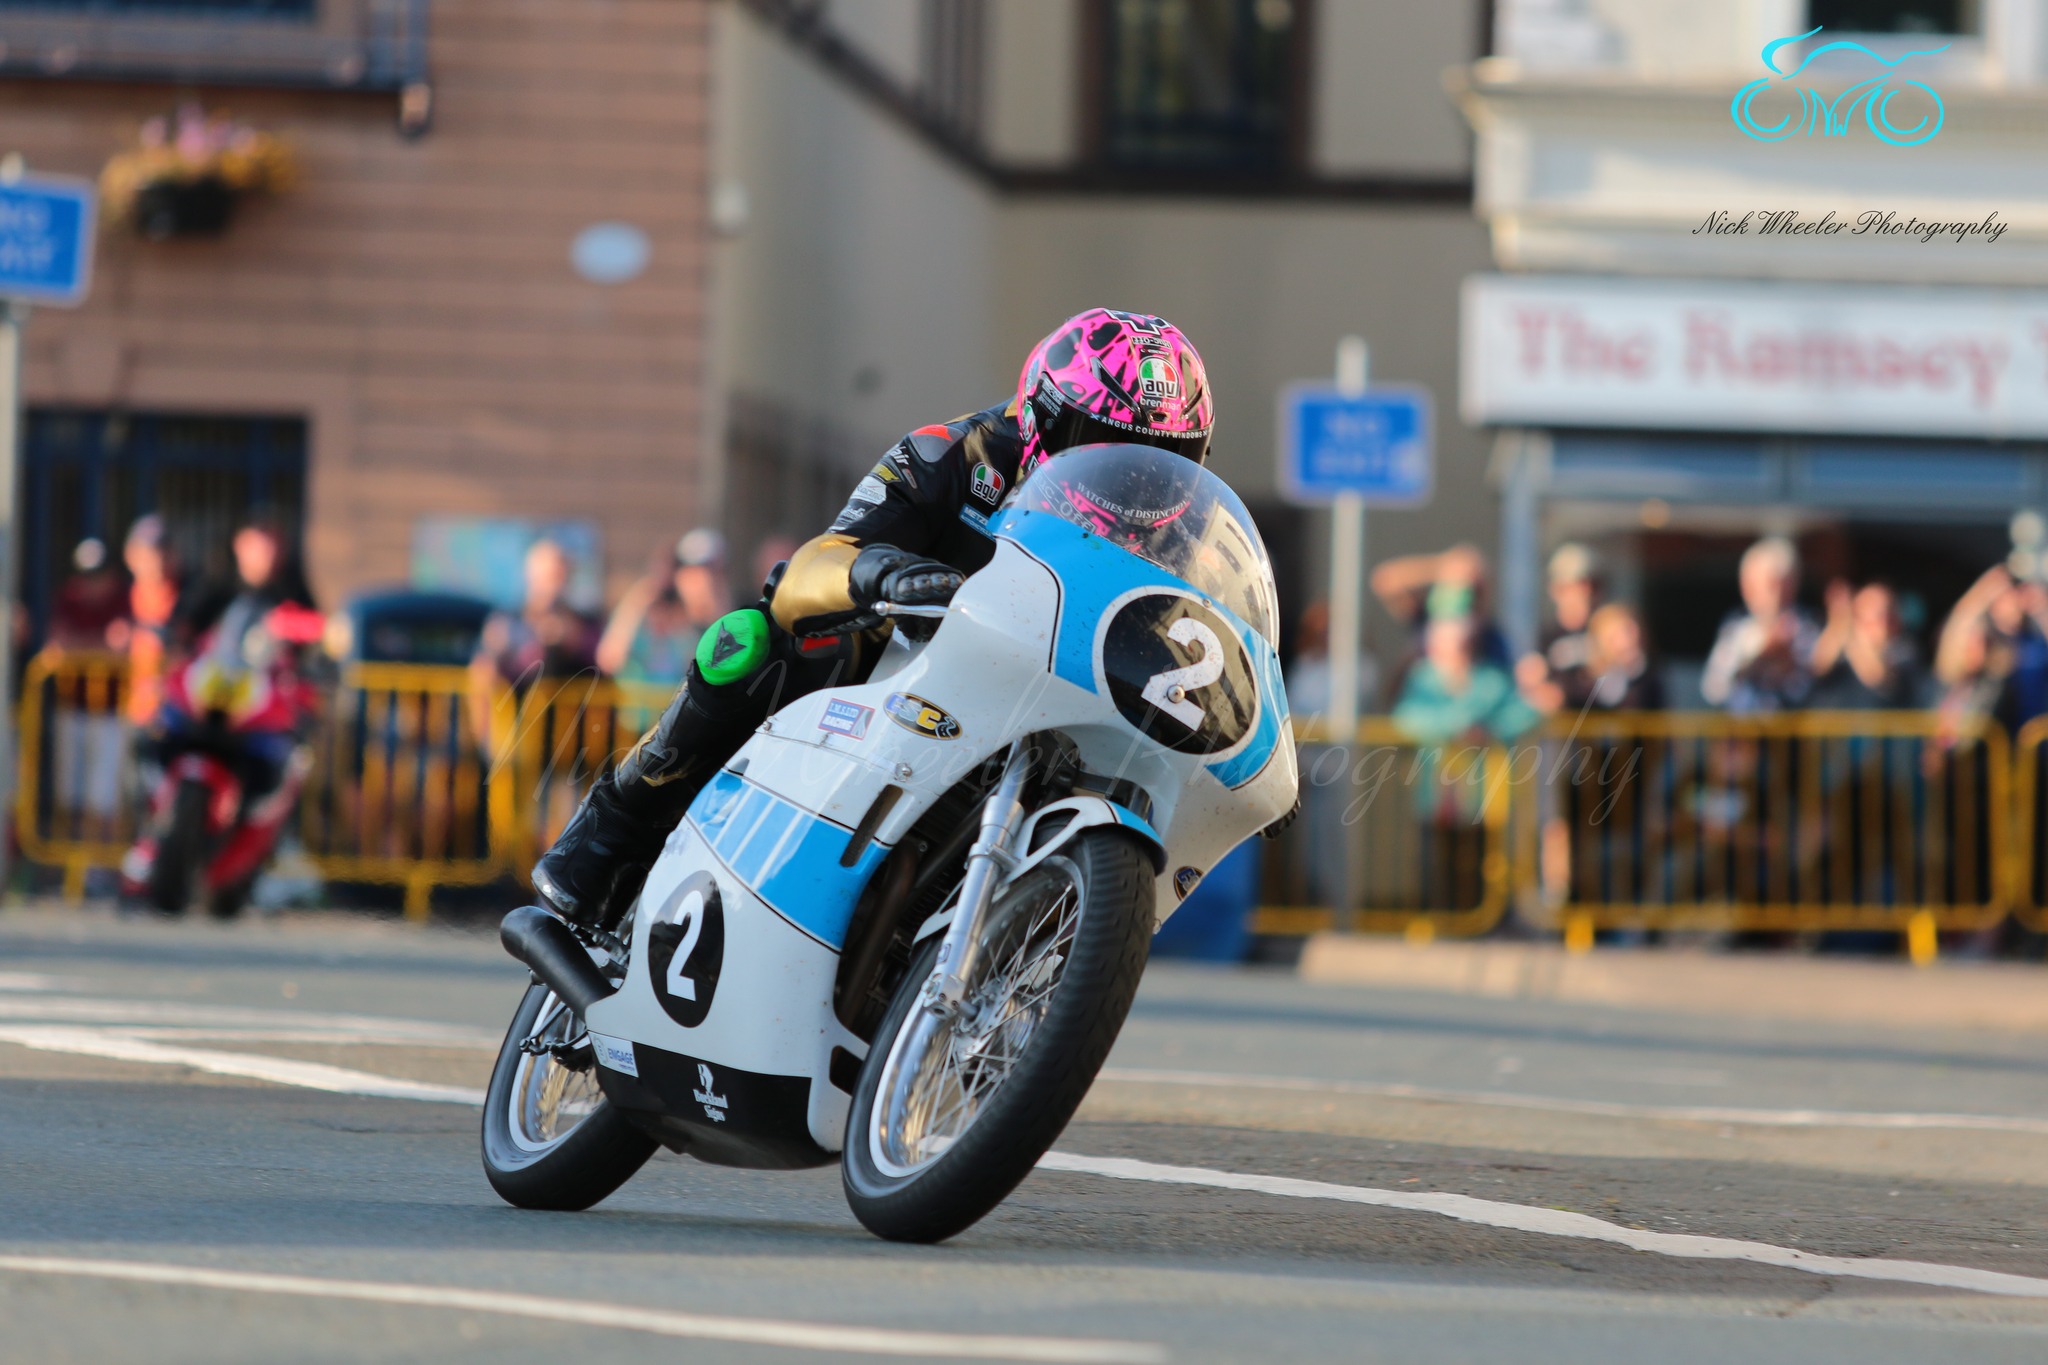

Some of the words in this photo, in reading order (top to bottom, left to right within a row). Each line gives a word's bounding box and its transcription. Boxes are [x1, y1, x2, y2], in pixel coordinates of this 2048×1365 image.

[1513, 304, 1652, 380] The
[1145, 379, 1175, 397] agv
[1101, 416, 1133, 432] ANGUS
[1135, 425, 1170, 439] COUNTY
[975, 480, 998, 499] agv
[1077, 482, 1123, 514] WATCHES
[1124, 508, 1133, 517] of
[1135, 500, 1187, 519] DISTINCTION
[1141, 617, 1225, 732] 2
[666, 890, 704, 1001] 2
